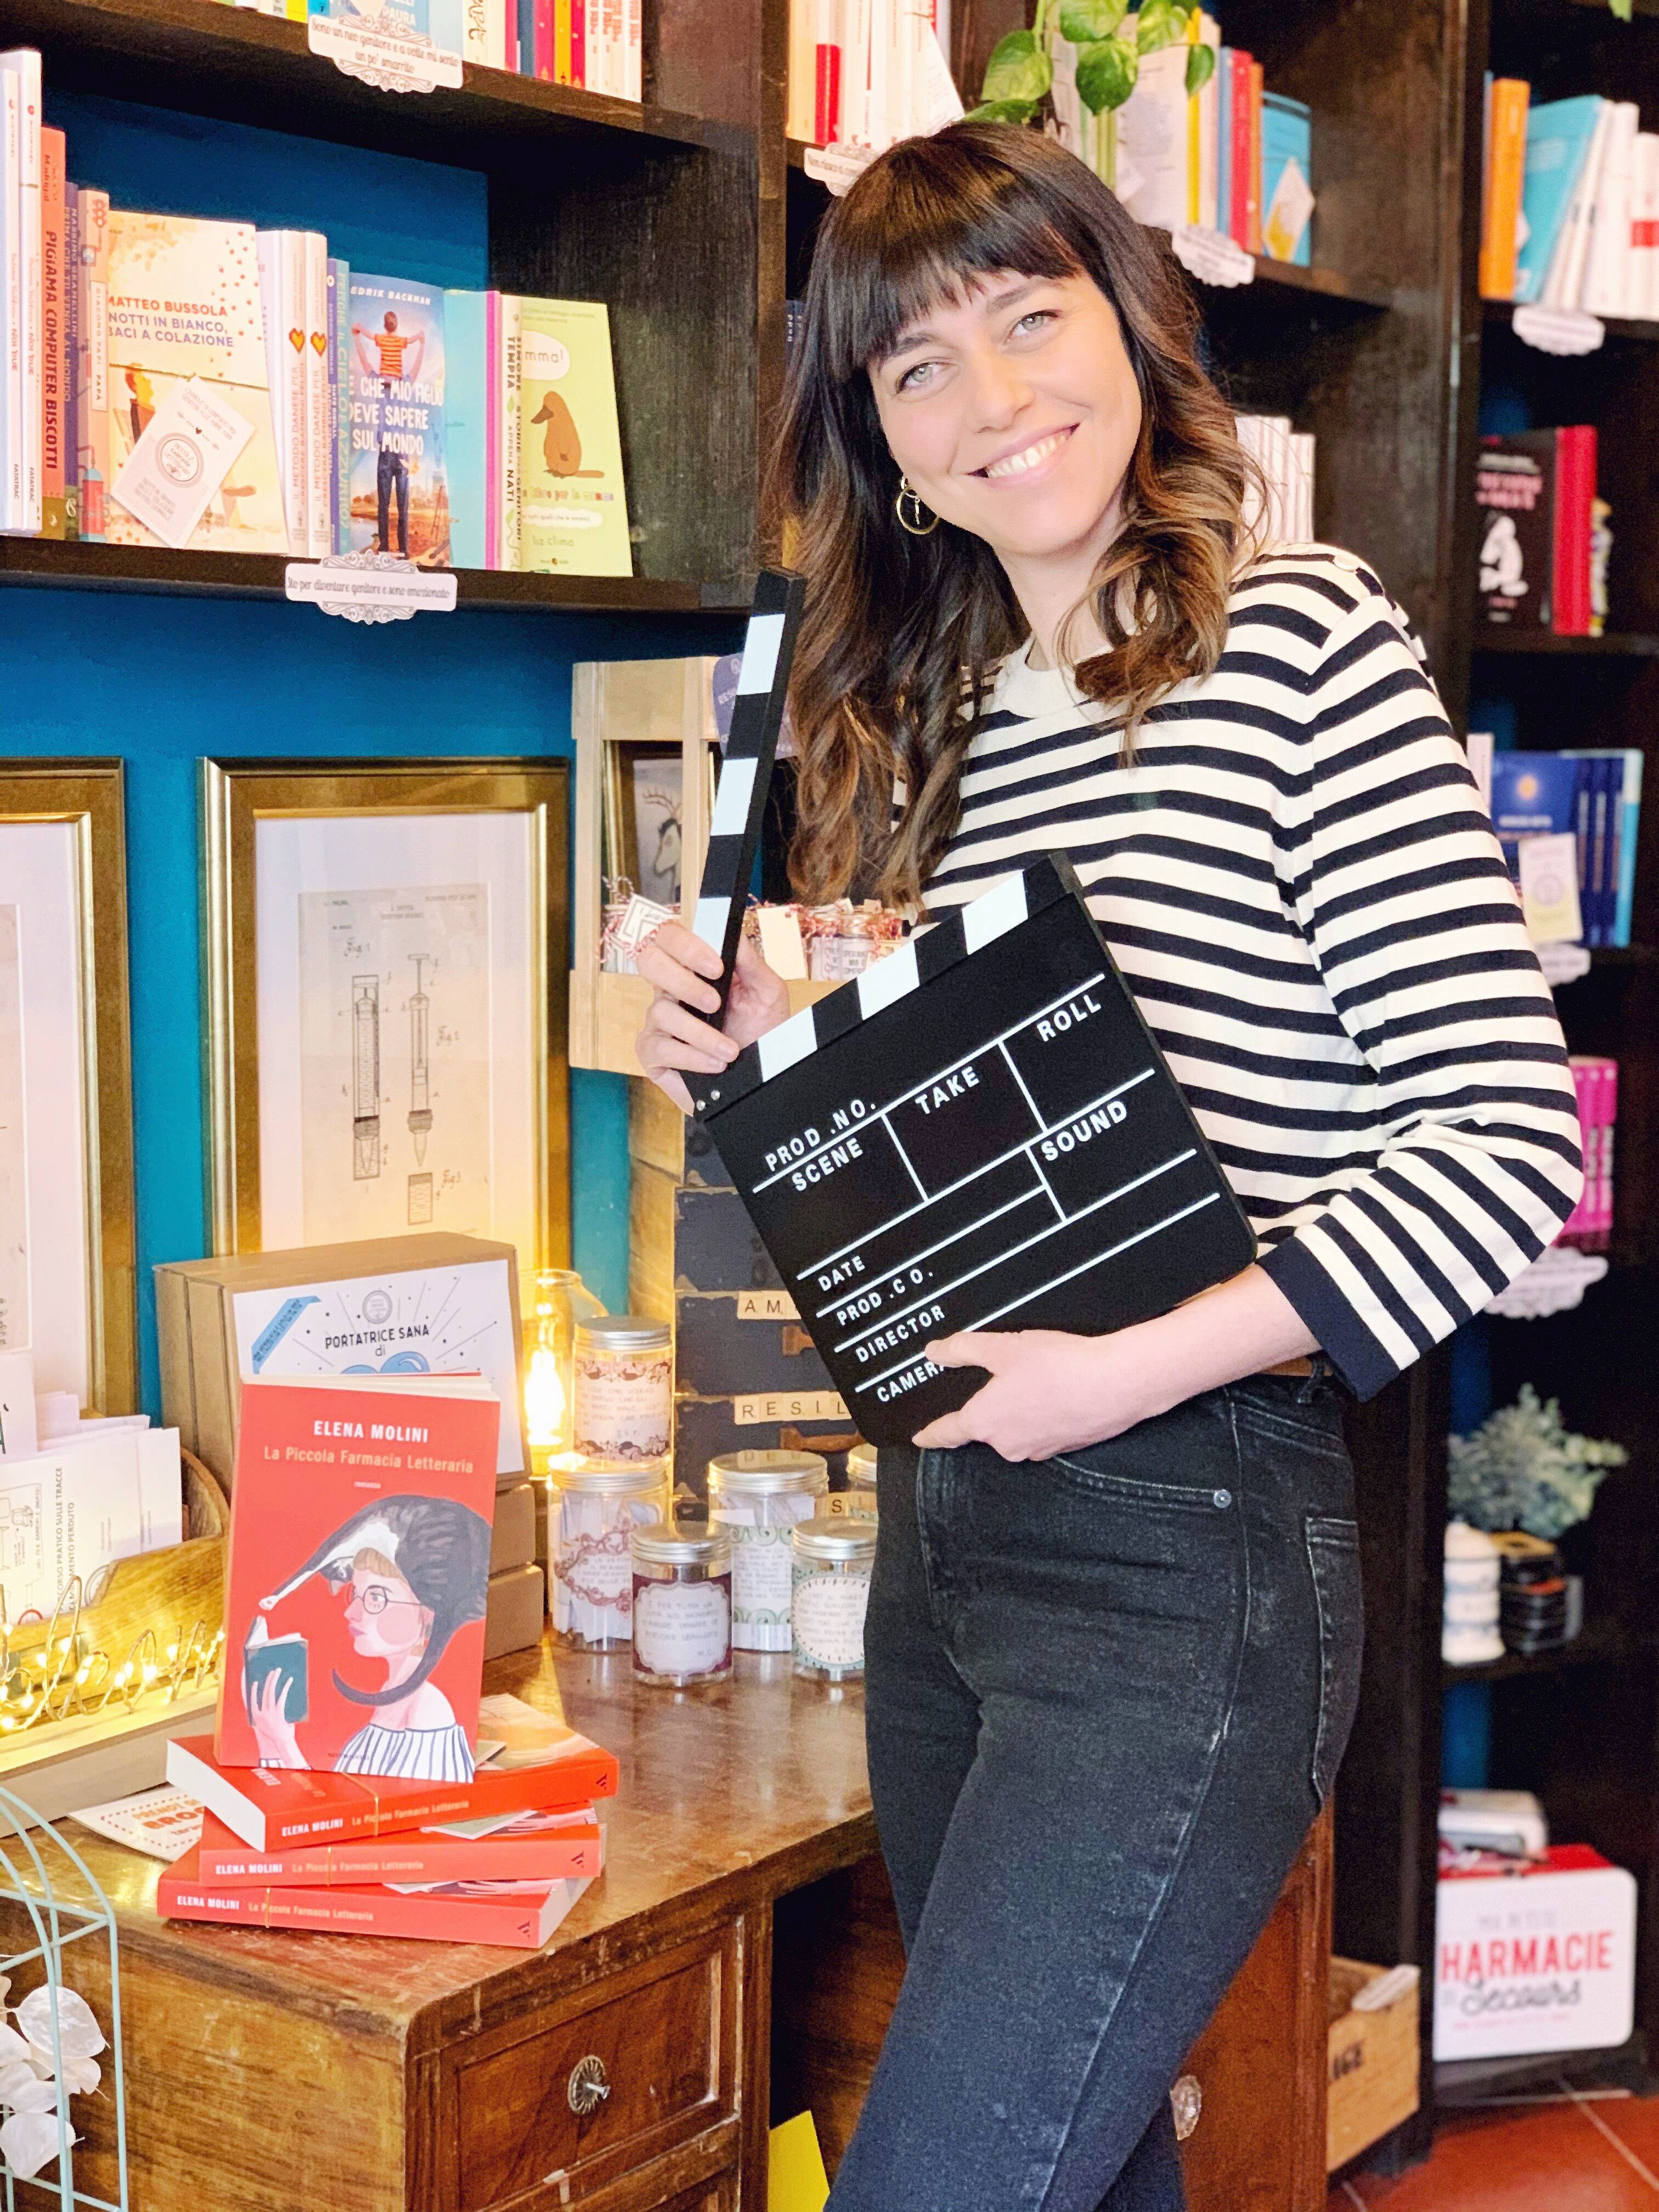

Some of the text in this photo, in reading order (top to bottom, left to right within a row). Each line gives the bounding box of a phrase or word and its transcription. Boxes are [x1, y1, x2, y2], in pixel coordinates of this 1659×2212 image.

[312, 19, 330, 34] Sono
[333, 28, 342, 38] un
[360, 35, 391, 51] genitore
[399, 46, 405, 54] a
[407, 46, 424, 58] volte
[427, 50, 437, 61] mi
[440, 55, 458, 67] sento
[356, 52, 365, 61] un
[381, 58, 415, 73] smarrito
[165, 301, 228, 316] BUSSOLA
[387, 291, 432, 306] BACKMAN
[108, 312, 228, 335] NOTTI IN BIANCO,
[46, 231, 57, 469] PIGIAMA COMPUTER BISCOTTI
[142, 329, 151, 340] A
[155, 331, 234, 347] COLAZIONE
[360, 376, 385, 399] CHE
[390, 380, 411, 401] MIO
[415, 382, 444, 407] FIGLIO
[385, 405, 428, 431] SAPERE
[352, 429, 424, 456] SUL MONDO
[532, 535, 575, 547] liz climo
[287, 576, 298, 589] Sto
[300, 580, 312, 592] per
[314, 578, 349, 593] diventare
[351, 583, 381, 596] genitore
[388, 586, 405, 596] sono
[407, 587, 450, 599] emozionato
[1035, 993, 1102, 1042] ROLL
[915, 1066, 980, 1115] TAKE
[1041, 1100, 1128, 1162] SOUND
[791, 1137, 864, 1191] SCENE
[818, 1255, 866, 1291] DATE
[325, 1324, 430, 1350] PORTATRICE SANA
[855, 1305, 945, 1362] DIRECTOR
[375, 1344, 386, 1356] di
[314, 1419, 429, 1444] ELENA MOLINI
[264, 1446, 473, 1474] La Piccola Farmacia Letteraria
[282, 1822, 309, 1837] ELENA
[313, 1818, 343, 1832] MOLINI
[352, 1817, 362, 1826] La
[394, 1807, 429, 1820] Farmacia
[432, 1801, 470, 1814] Letteraria
[216, 1865, 245, 1875] ELENA
[249, 1864, 283, 1874] MOLINI
[292, 1864, 303, 1874] La
[340, 1862, 379, 1871] Farmacia
[381, 1861, 424, 1871] Letteraria
[177, 1895, 204, 1907] ELENA
[207, 1898, 239, 1910] MOLINI
[249, 1902, 258, 1912] La
[293, 1905, 330, 1918] Farmacia
[332, 1909, 374, 1921] Letteraria
[1440, 1930, 1615, 1983] HARMACIE
